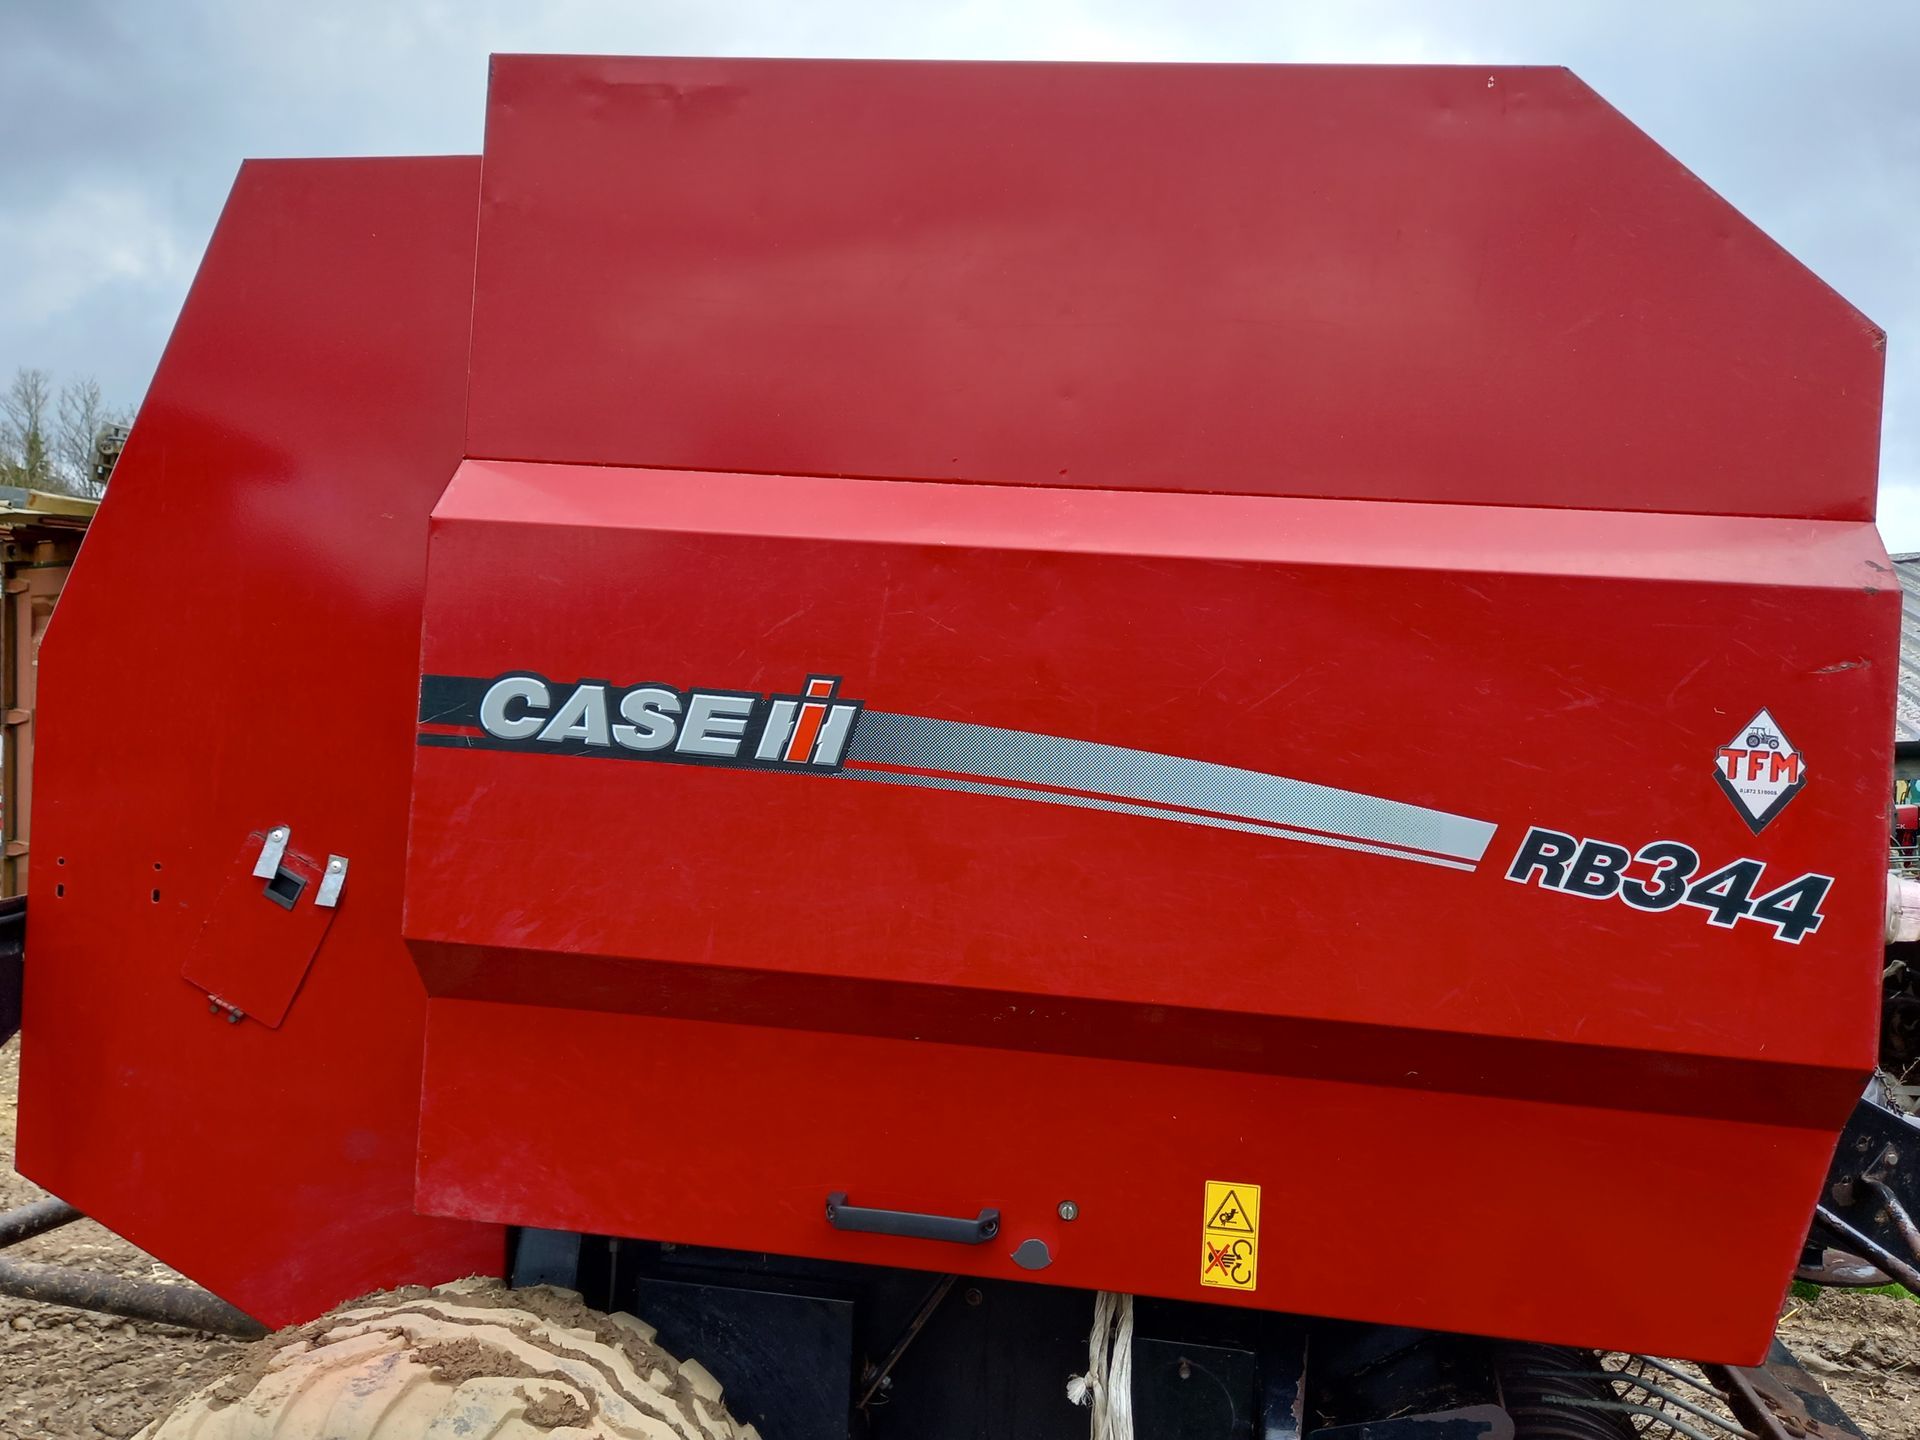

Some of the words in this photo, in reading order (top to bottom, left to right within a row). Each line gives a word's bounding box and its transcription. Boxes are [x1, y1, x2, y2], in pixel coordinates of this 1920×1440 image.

[480, 676, 756, 757] CASE
[1720, 748, 1799, 783] TFM
[1504, 826, 1835, 944] RB344
